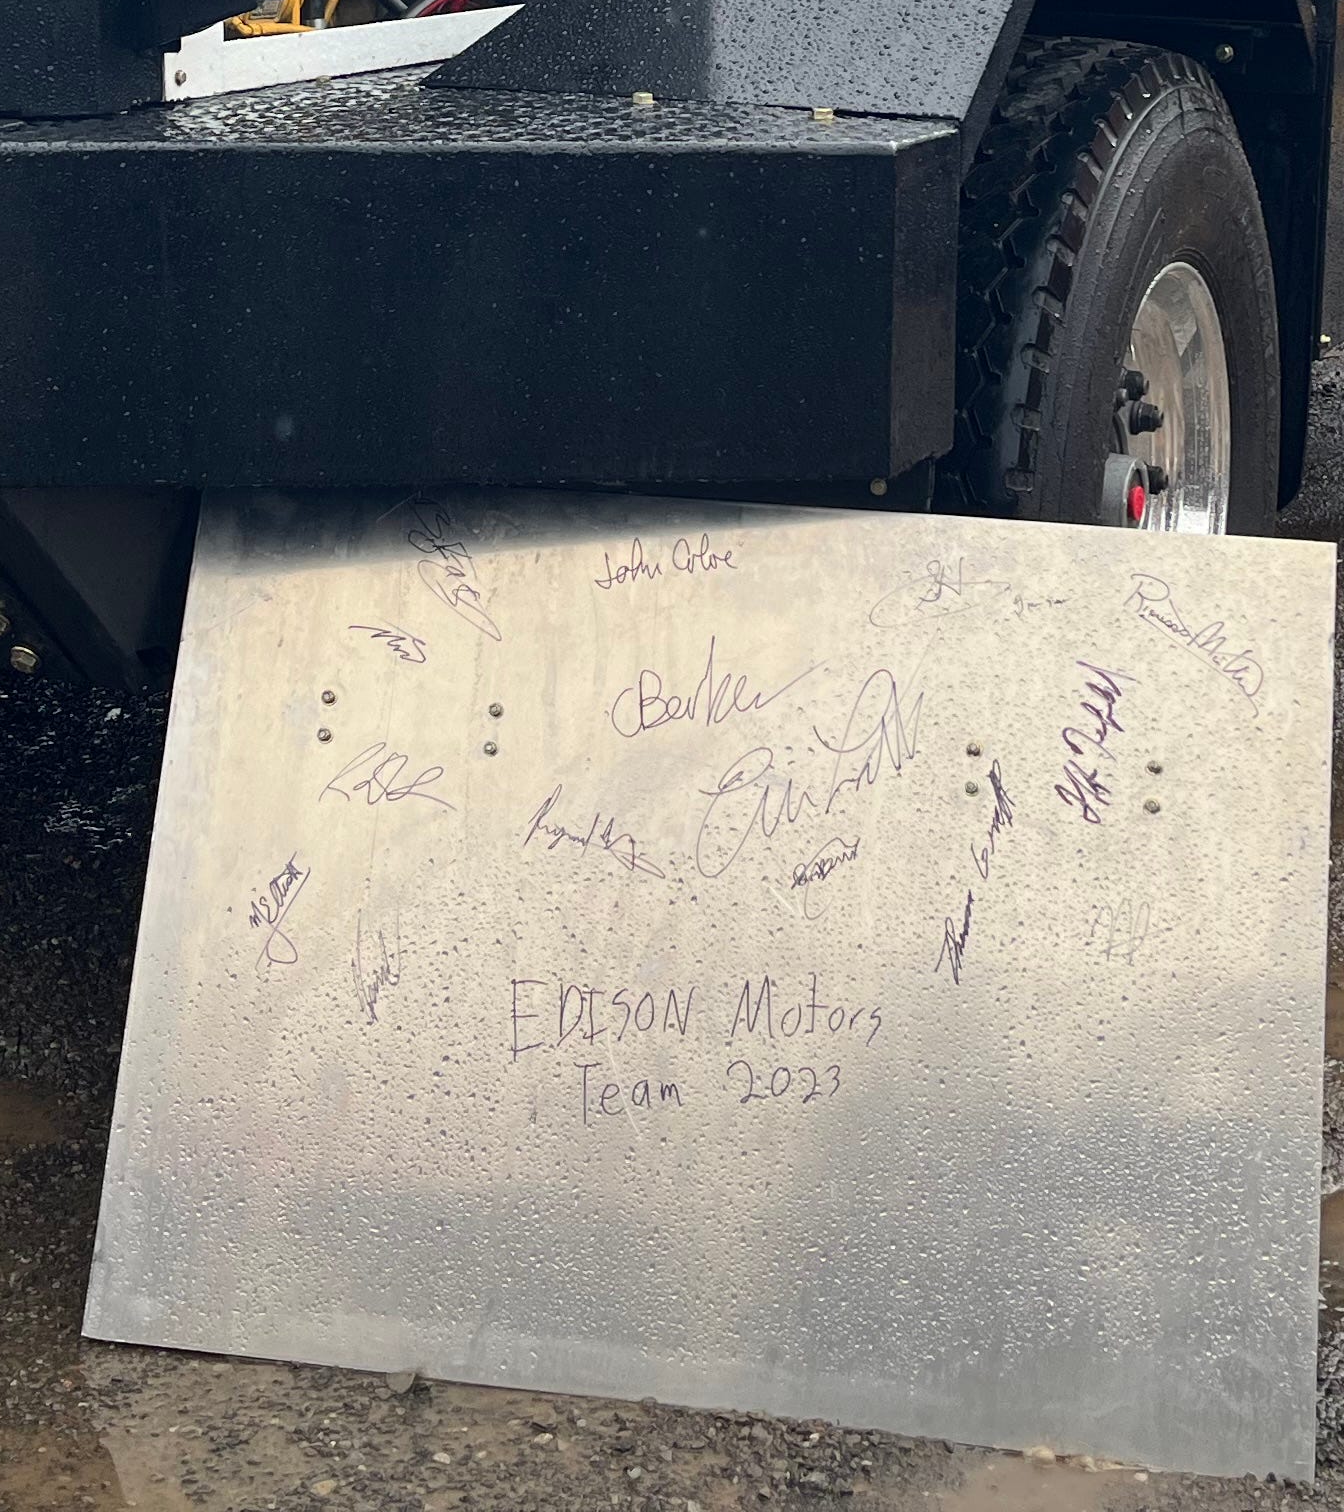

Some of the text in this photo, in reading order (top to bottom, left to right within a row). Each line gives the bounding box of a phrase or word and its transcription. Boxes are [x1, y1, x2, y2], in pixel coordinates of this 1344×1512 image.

[510, 971, 883, 1063] EDISON Motors
[573, 1059, 843, 1126] Team 2023
